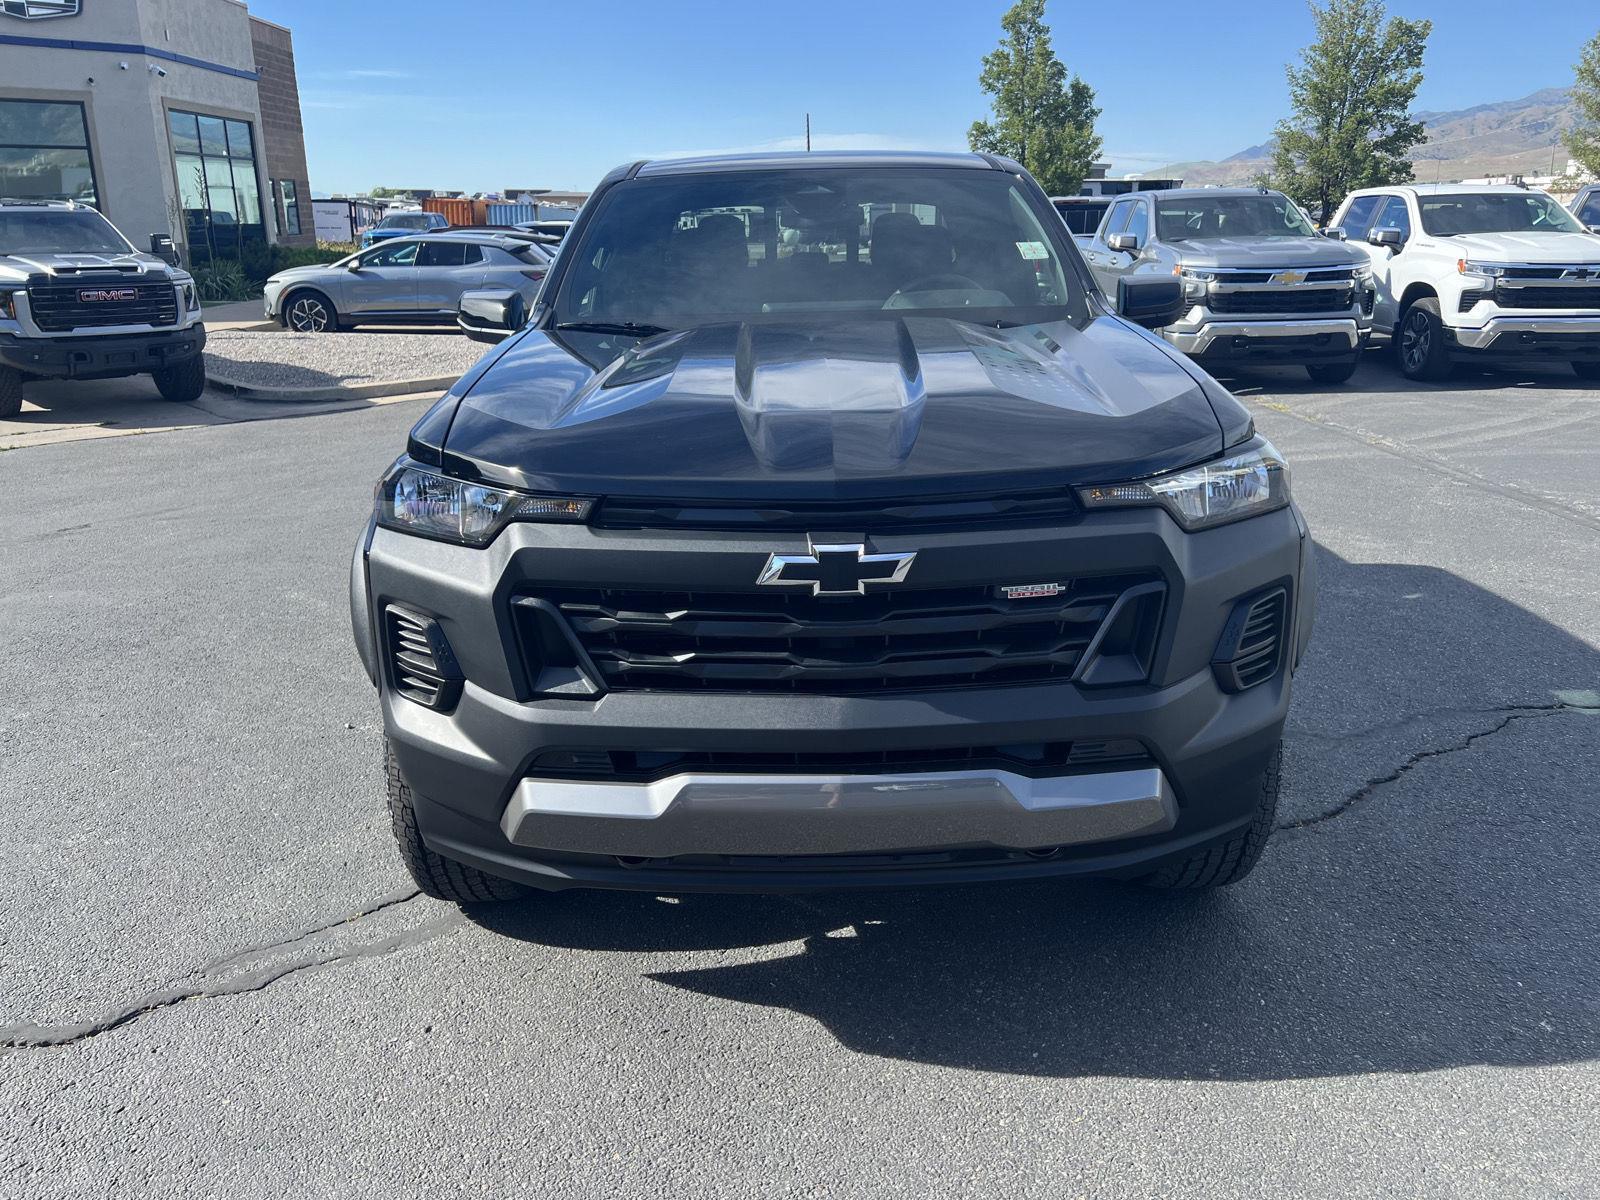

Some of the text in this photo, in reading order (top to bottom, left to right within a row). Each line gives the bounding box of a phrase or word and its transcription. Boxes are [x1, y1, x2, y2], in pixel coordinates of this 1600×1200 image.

[81, 290, 135, 301] GMC
[1002, 583, 1065, 593] TRAIL
[1008, 590, 1058, 599] BOSS
